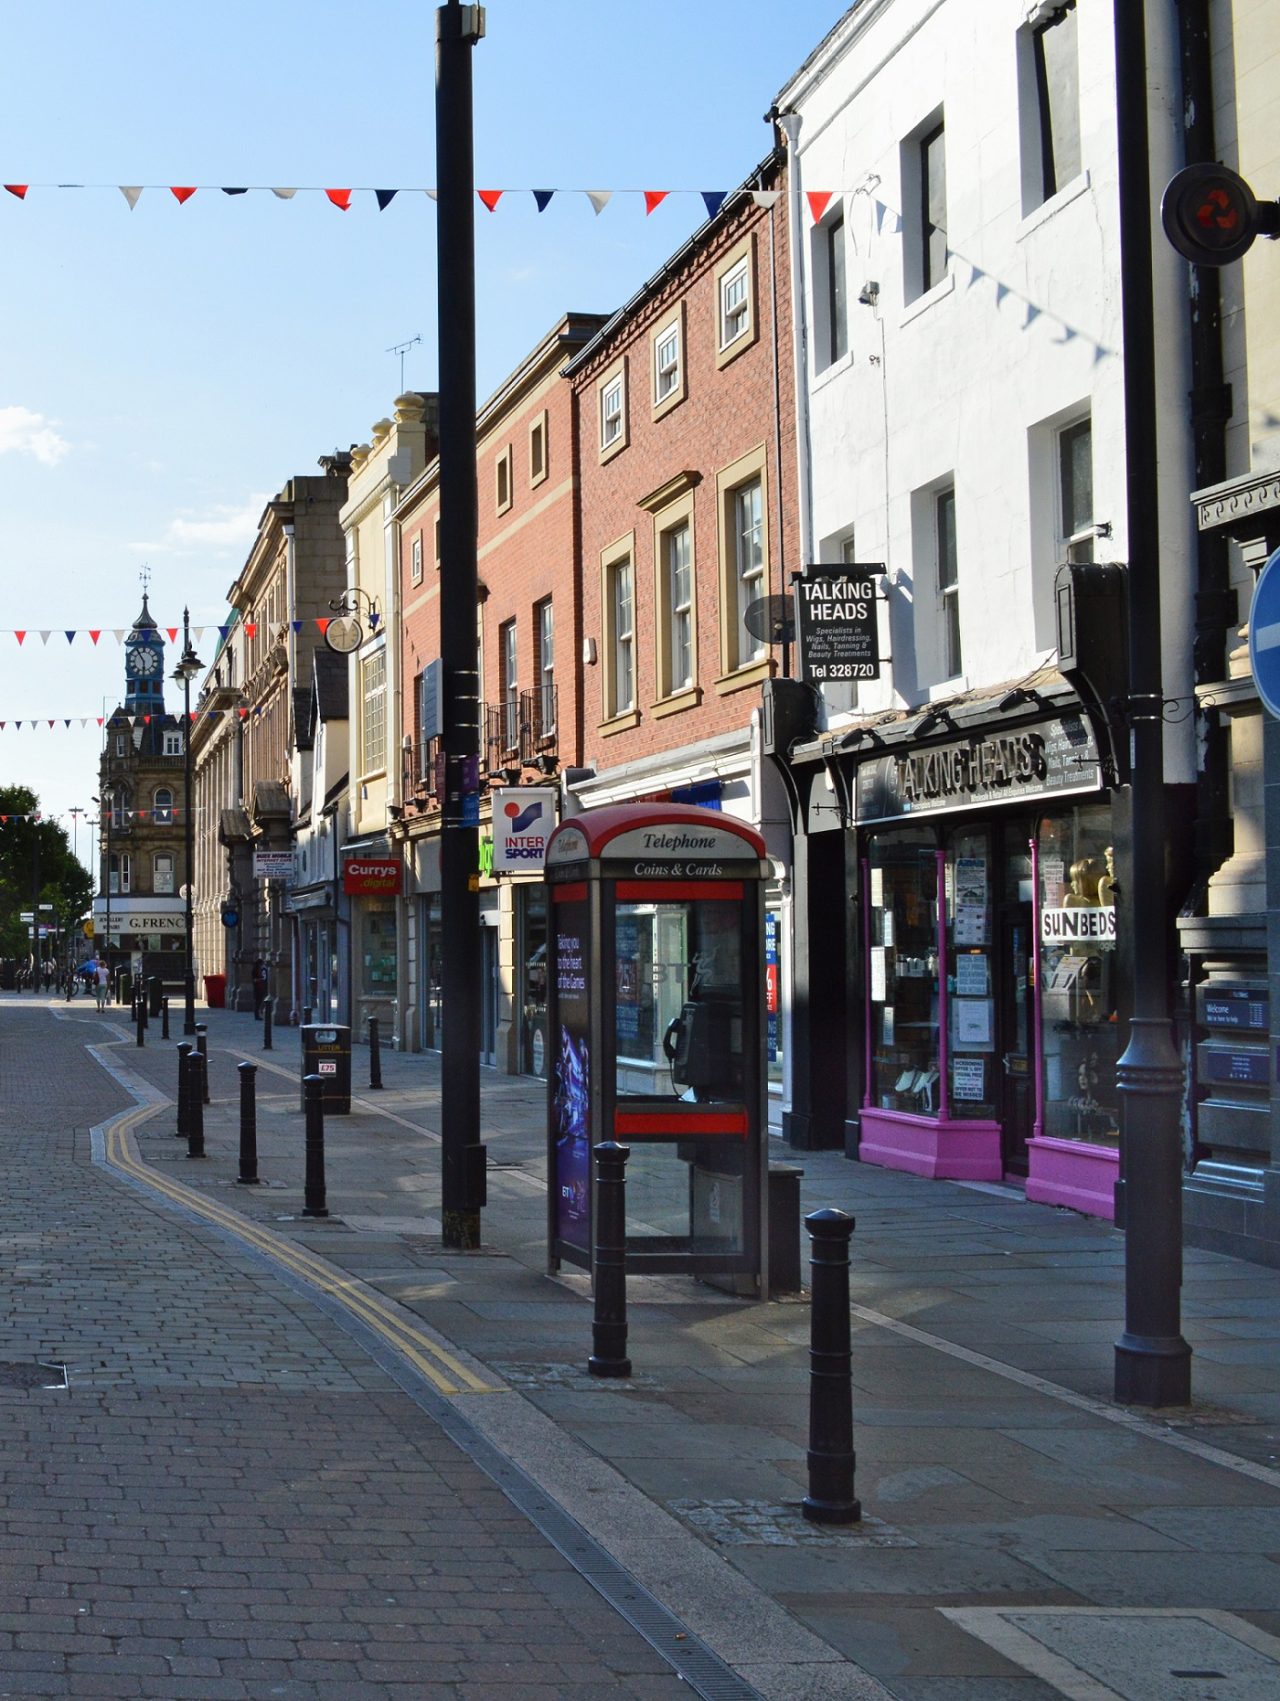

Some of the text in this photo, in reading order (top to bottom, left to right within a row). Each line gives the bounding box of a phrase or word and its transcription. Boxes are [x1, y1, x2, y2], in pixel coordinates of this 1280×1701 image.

[802, 582, 873, 601] TALKING
[810, 602, 868, 621] HEADS
[815, 627, 853, 636] Specialists
[806, 634, 872, 644] Wigs, Hairdressing,
[833, 642, 860, 651] Tanning
[808, 651, 832, 659] Beauty
[809, 663, 875, 677] Tel 328720
[968, 733, 1034, 786] HEADS
[1064, 769, 1094, 784] Treatments
[505, 836, 544, 848] INTER
[643, 834, 716, 851] Telephone
[505, 848, 545, 860] SPORT
[348, 864, 397, 880] Currys
[634, 863, 723, 876] Coins & Cards
[570, 974, 585, 989] Games
[1206, 1002, 1230, 1014] Welcome
